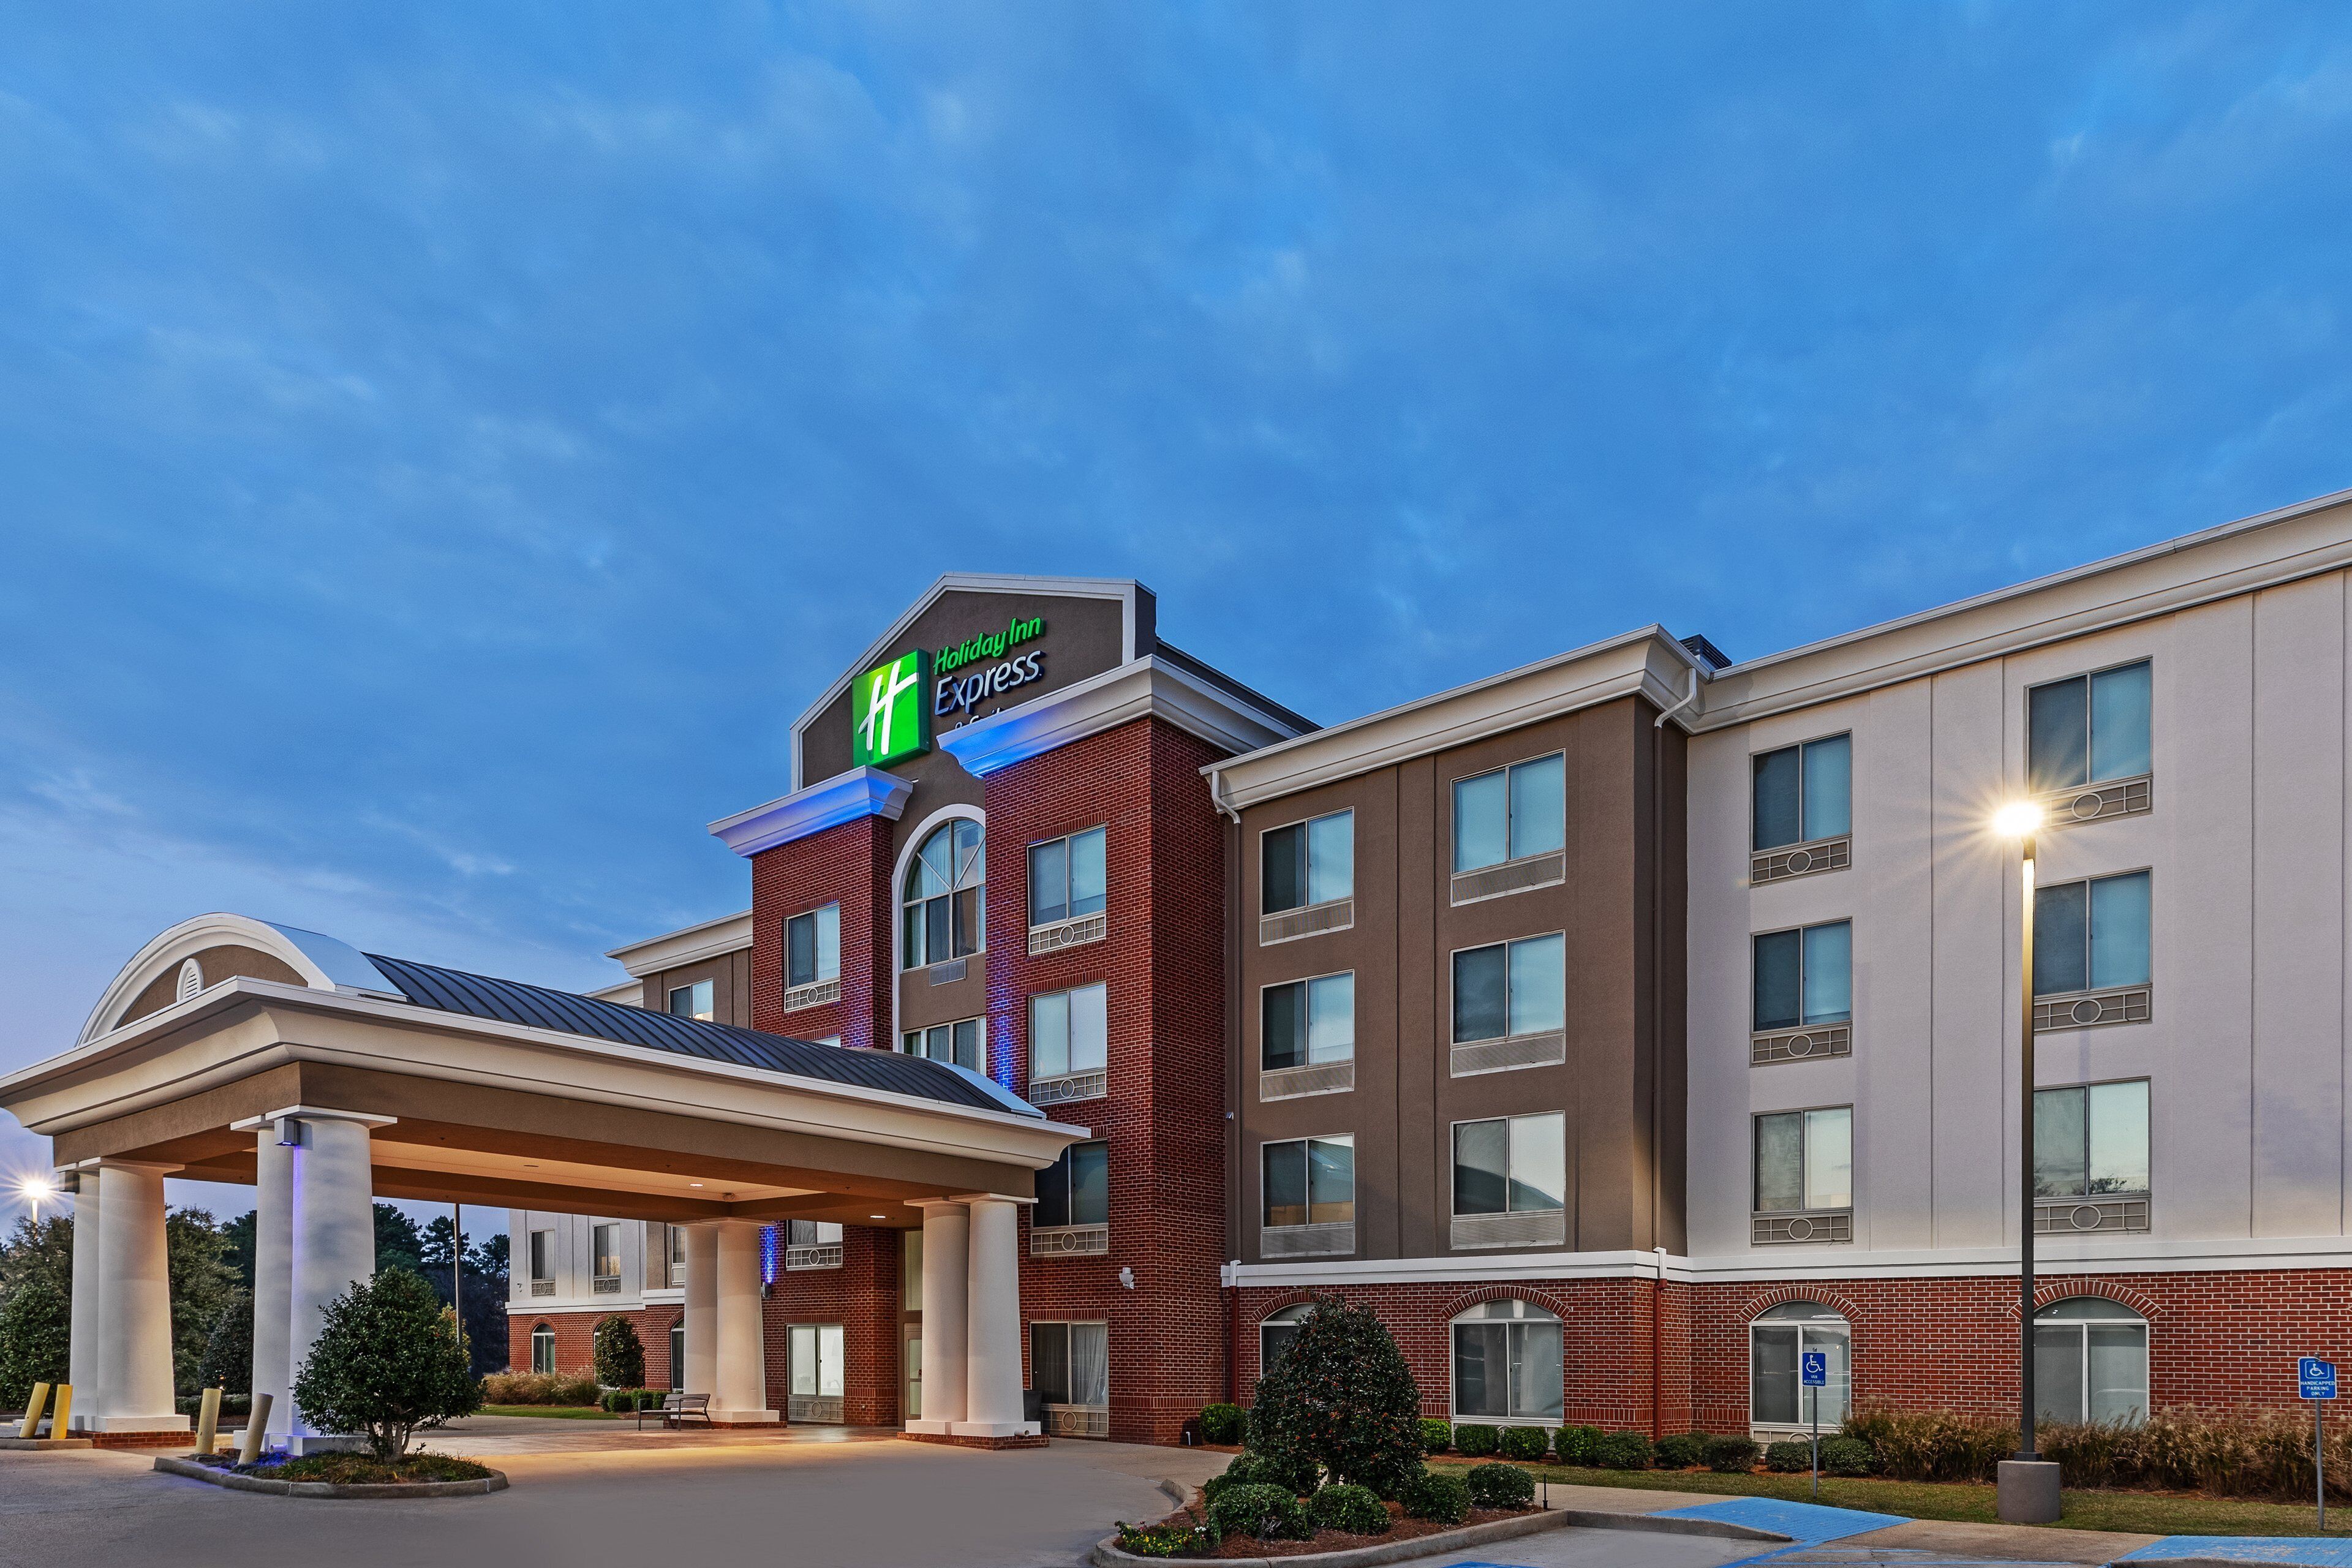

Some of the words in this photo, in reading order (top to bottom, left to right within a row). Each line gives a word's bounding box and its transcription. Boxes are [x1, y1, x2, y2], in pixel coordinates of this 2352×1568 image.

[933, 631, 1007, 676] Holiday
[1009, 616, 1041, 646] Inn
[934, 650, 1042, 716] Express
